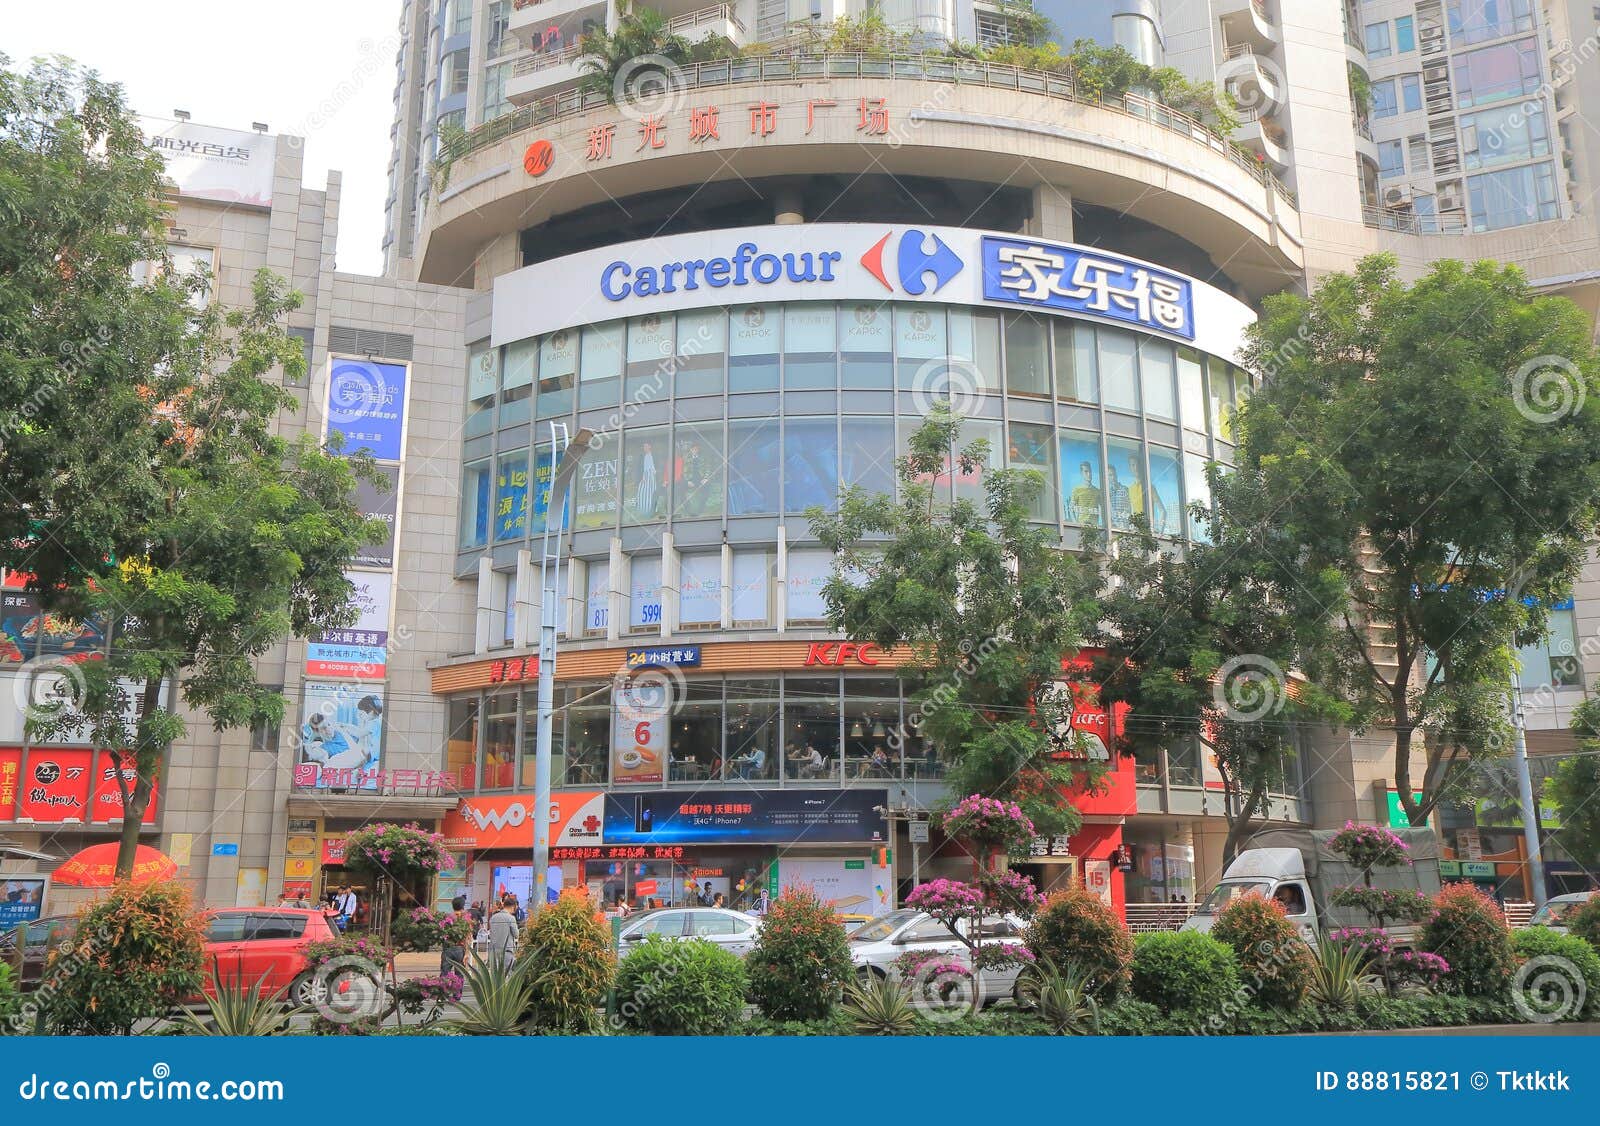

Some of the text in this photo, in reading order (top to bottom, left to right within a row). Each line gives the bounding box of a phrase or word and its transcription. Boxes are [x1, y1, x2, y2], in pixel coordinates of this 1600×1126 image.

[585, 96, 891, 161] 新光城市广场
[600, 241, 841, 302] Carrefour
[998, 246, 1184, 329] 家乐福
[738, 328, 771, 339] KAPOK
[904, 333, 937, 342] KAPOK
[629, 649, 694, 665] 24 小时营业
[803, 642, 879, 666] KFC
[1075, 713, 1106, 725] KFC
[635, 721, 651, 746] 6
[715, 817, 742, 825] iPhone7
[1089, 871, 1104, 887] 15
